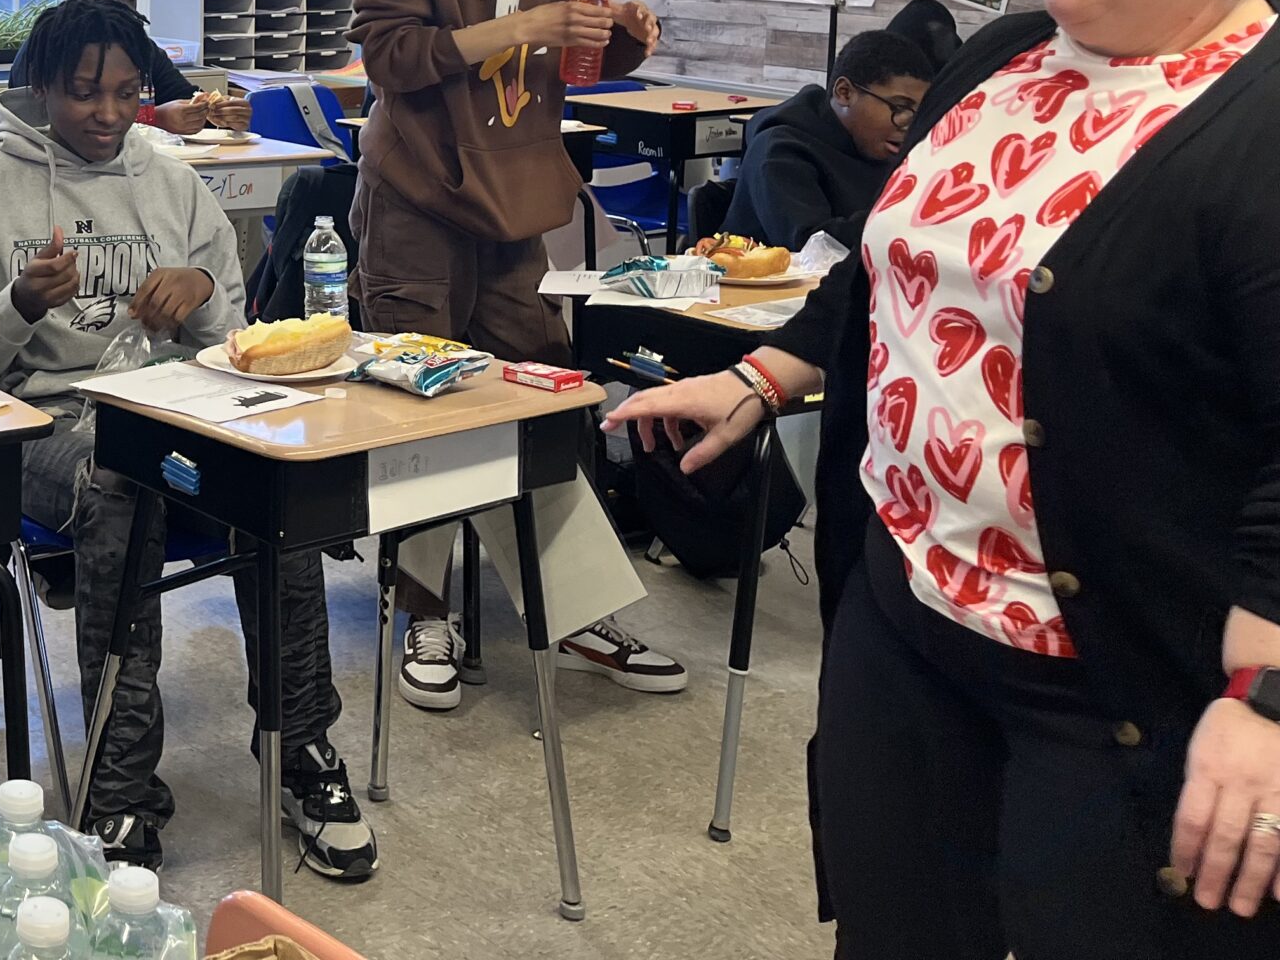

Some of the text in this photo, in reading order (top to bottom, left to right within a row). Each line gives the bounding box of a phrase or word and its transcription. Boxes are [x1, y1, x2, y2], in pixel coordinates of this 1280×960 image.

[638, 140, 657, 157] Room
[18, 239, 54, 247] NATIONA
[63, 237, 99, 245] OOTBALL
